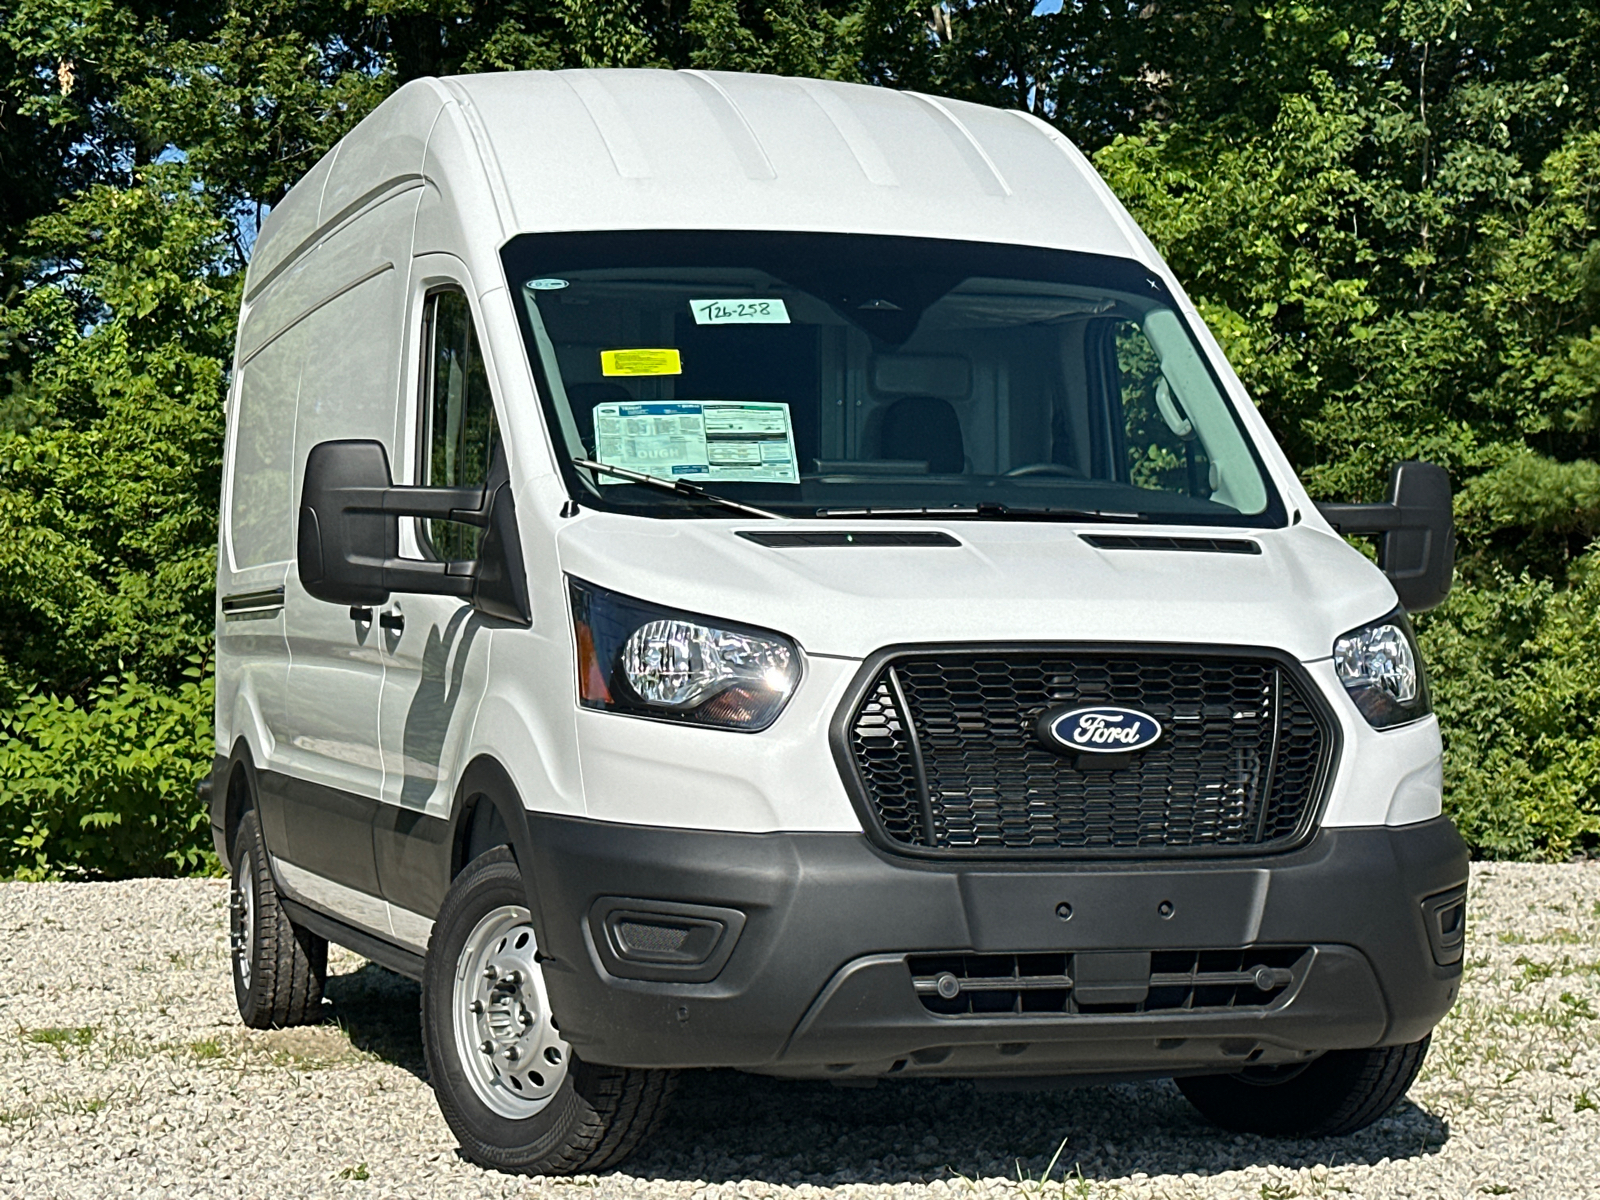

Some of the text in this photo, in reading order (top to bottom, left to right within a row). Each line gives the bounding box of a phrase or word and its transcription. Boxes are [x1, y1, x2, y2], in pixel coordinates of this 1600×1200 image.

[700, 301, 771, 321] T26-258
[628, 448, 680, 460] OUGH
[1073, 713, 1141, 744] Ford
